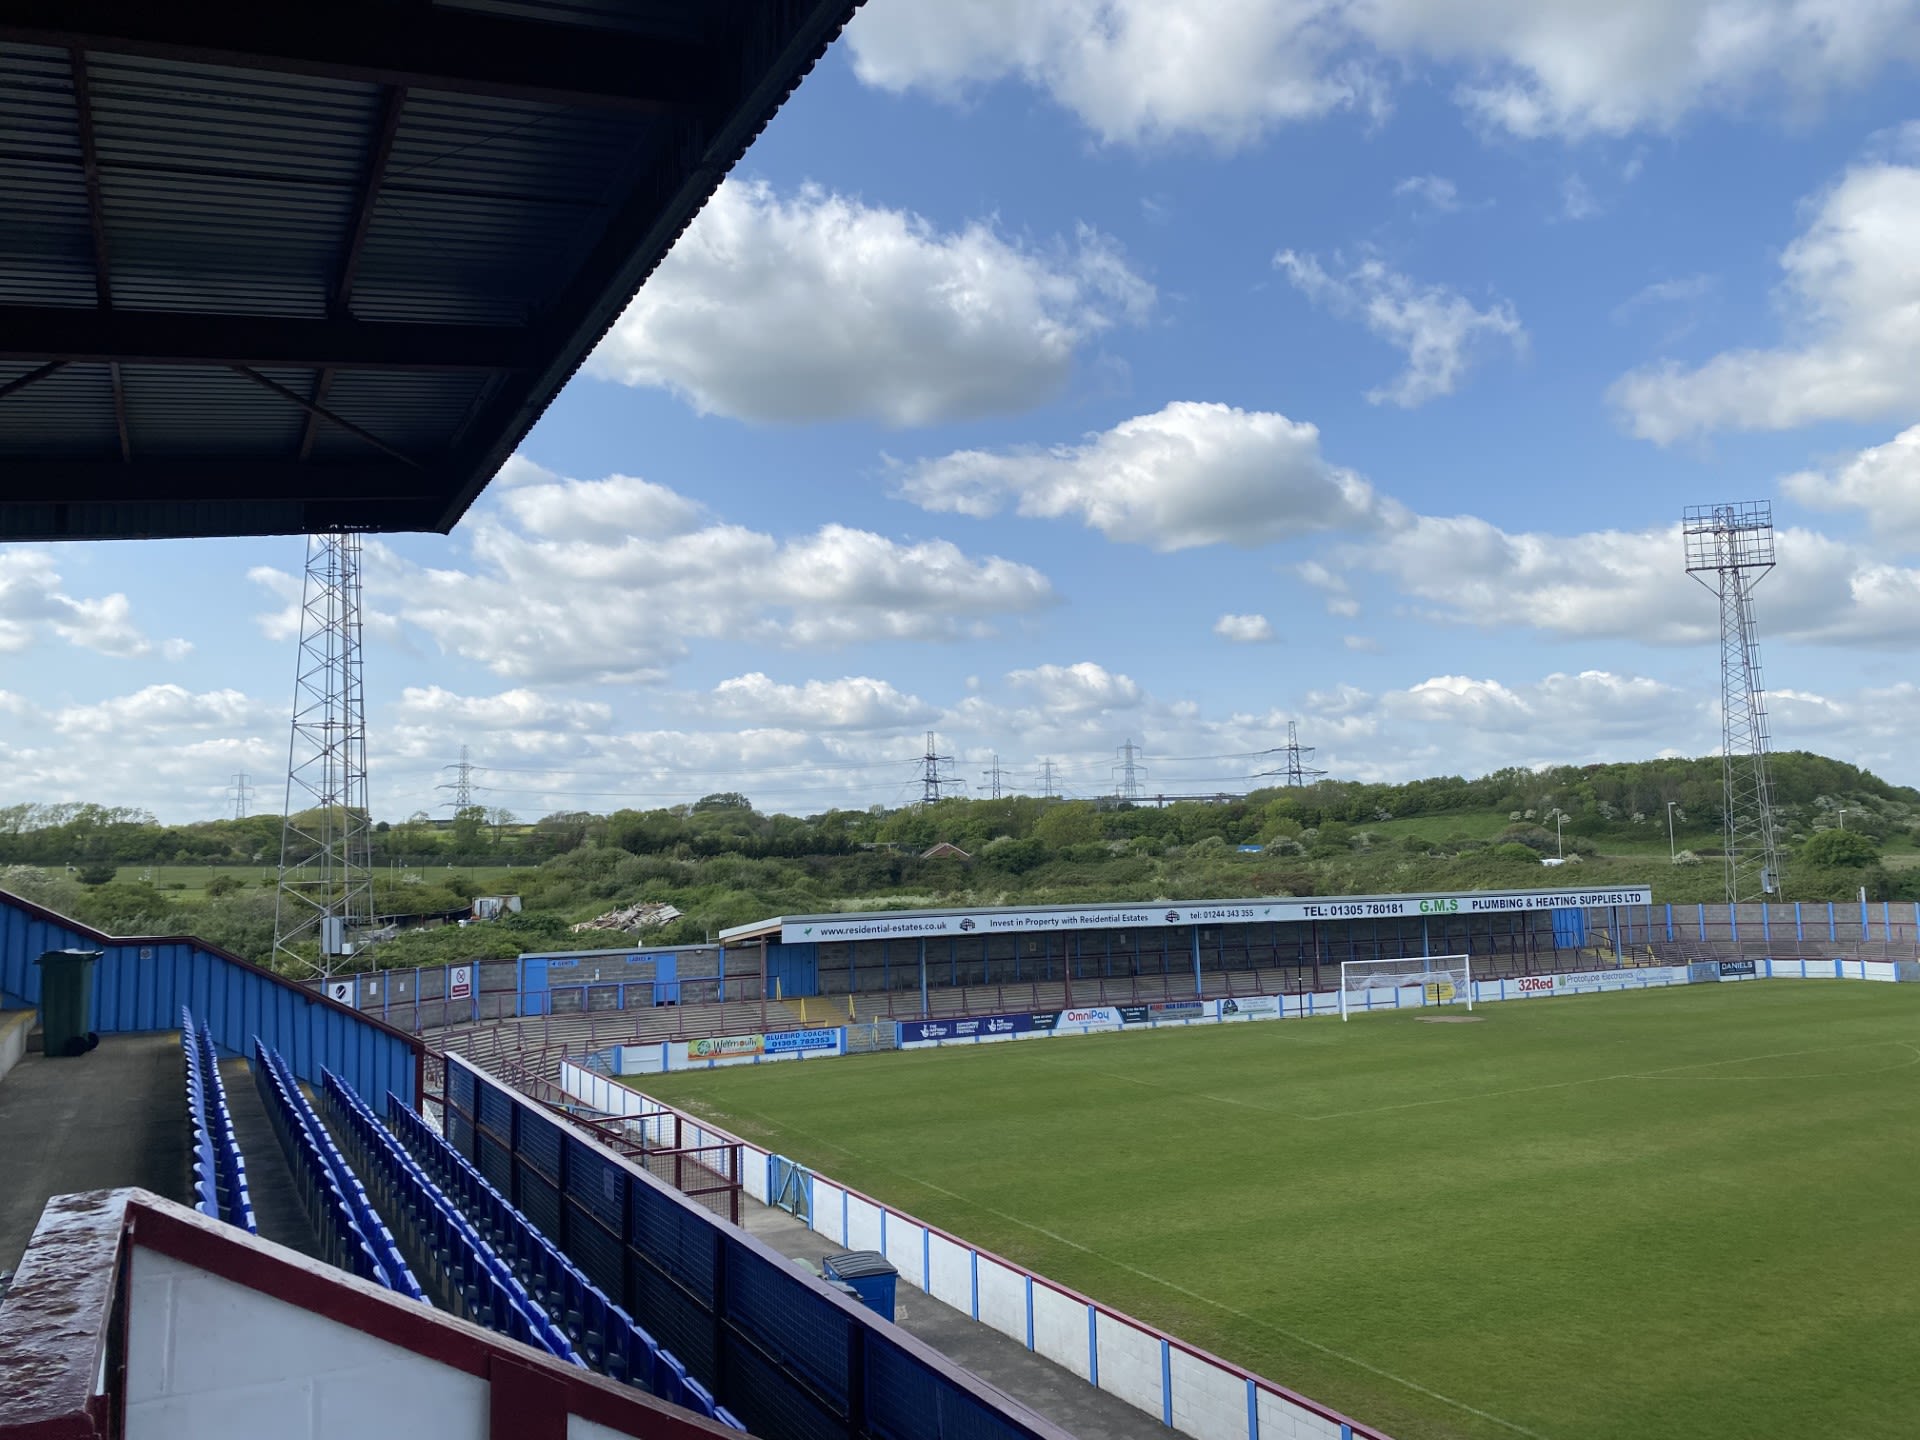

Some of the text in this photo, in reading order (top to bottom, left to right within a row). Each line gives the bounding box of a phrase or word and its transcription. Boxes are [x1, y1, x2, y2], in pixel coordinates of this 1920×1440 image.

[1419, 899, 1458, 913] G.M.S
[1472, 893, 1641, 910] PLUMBING & HEATING SUPPLIES LTD
[1190, 909, 1254, 919] tel: 01244 343 355
[1303, 903, 1403, 917] TEL: 01305 780181
[990, 914, 1149, 928] Invest in Property with Residential Estates
[820, 921, 947, 937] www.residential-estates.co.uk
[1721, 961, 1753, 970] DANIELS
[1518, 977, 1553, 991] 32Red
[1567, 974, 1600, 985] Prototype
[1602, 971, 1634, 981] Electronics
[1067, 1009, 1110, 1022] OmniPay
[766, 1029, 836, 1042] BLUEBIRD COACHES
[771, 1039, 797, 1048] 01305
